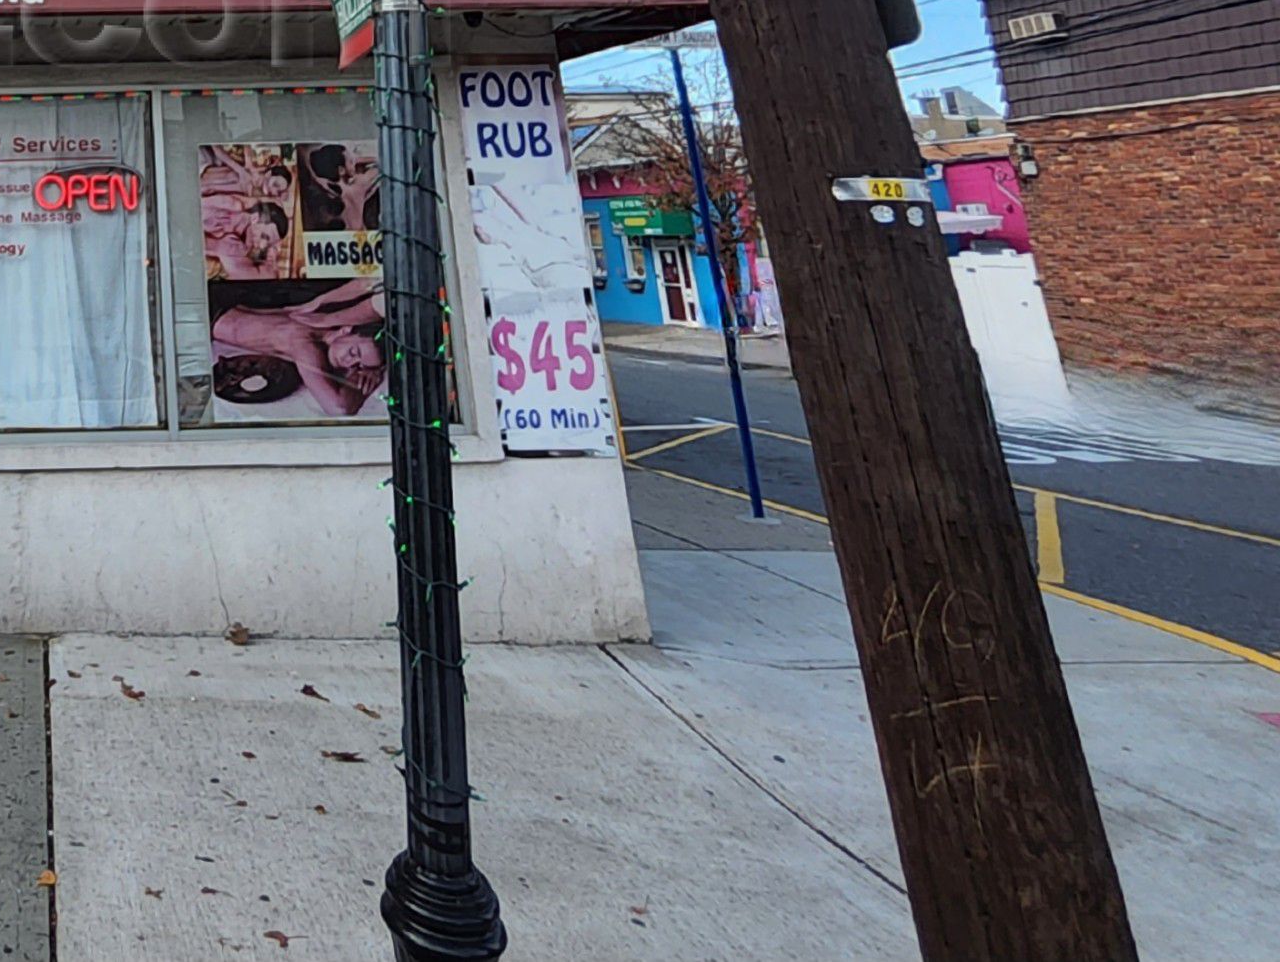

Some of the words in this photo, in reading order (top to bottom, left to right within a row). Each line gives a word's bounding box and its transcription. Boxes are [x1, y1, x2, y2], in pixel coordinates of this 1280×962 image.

[459, 69, 555, 109] FOOT
[13, 137, 101, 154] Services
[476, 121, 554, 159] RUB
[35, 172, 140, 212] OPEN
[871, 182, 904, 198] 420
[21, 210, 82, 225] Massage
[307, 240, 384, 267] MASSAG
[491, 316, 596, 395] $45
[504, 408, 541, 431] (60
[551, 406, 601, 430] Min)
